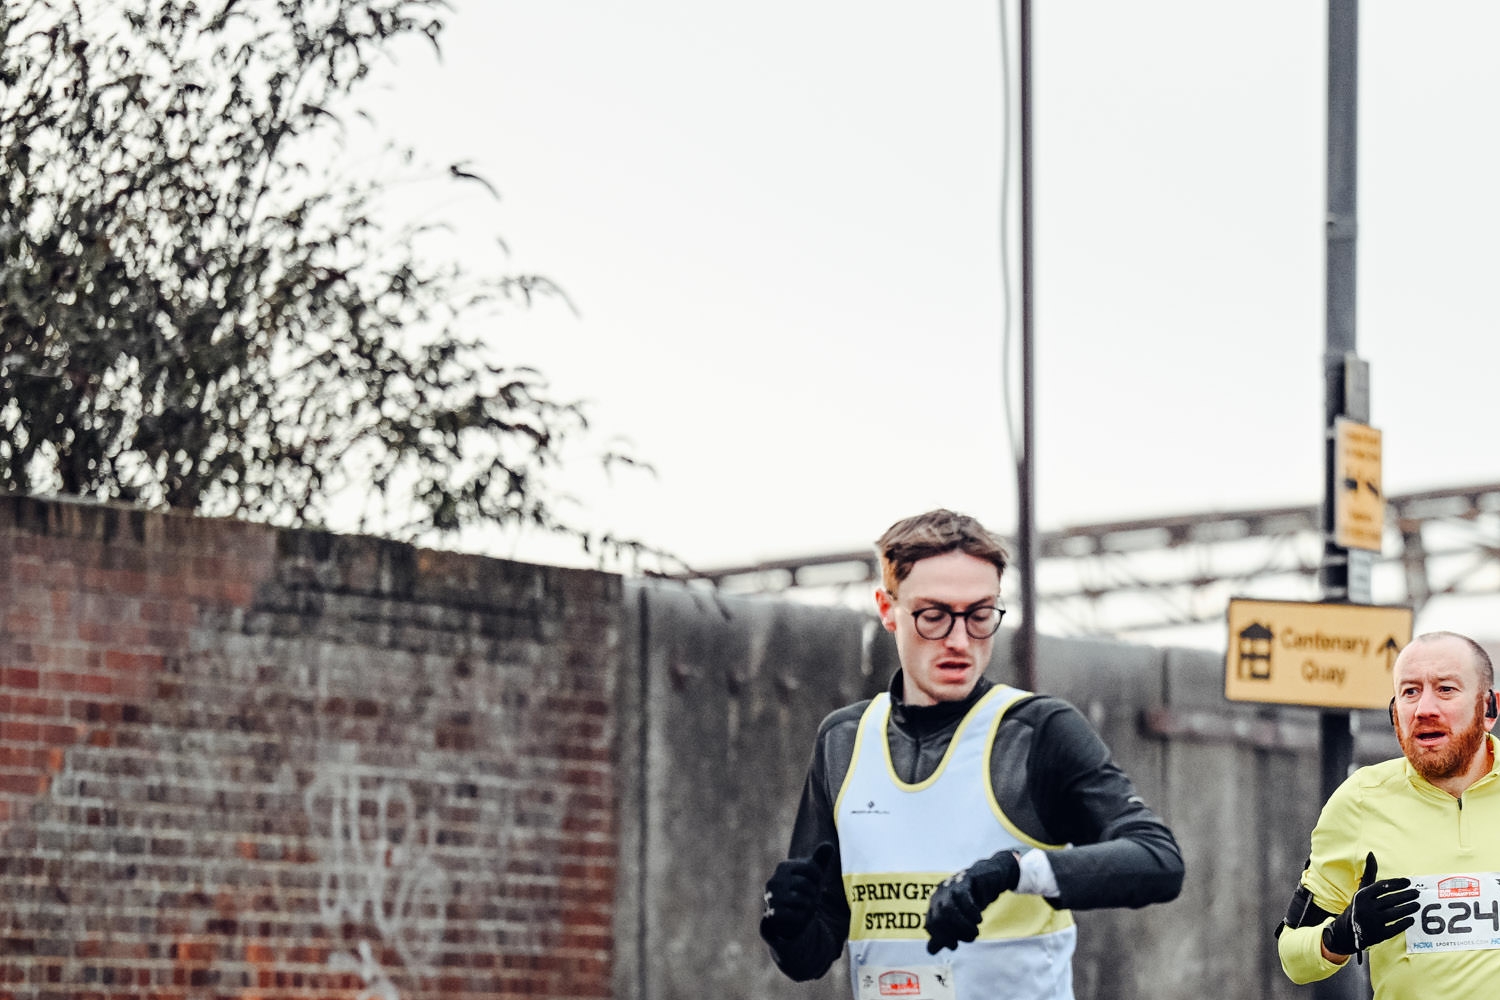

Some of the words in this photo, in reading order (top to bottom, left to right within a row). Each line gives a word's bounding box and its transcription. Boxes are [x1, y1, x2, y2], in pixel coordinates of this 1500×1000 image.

[1281, 627, 1370, 657] Centenary
[1301, 659, 1346, 687] Quay
[852, 882, 938, 902] PRINGF
[865, 912, 928, 930] STRID
[1421, 900, 1500, 935] 624
